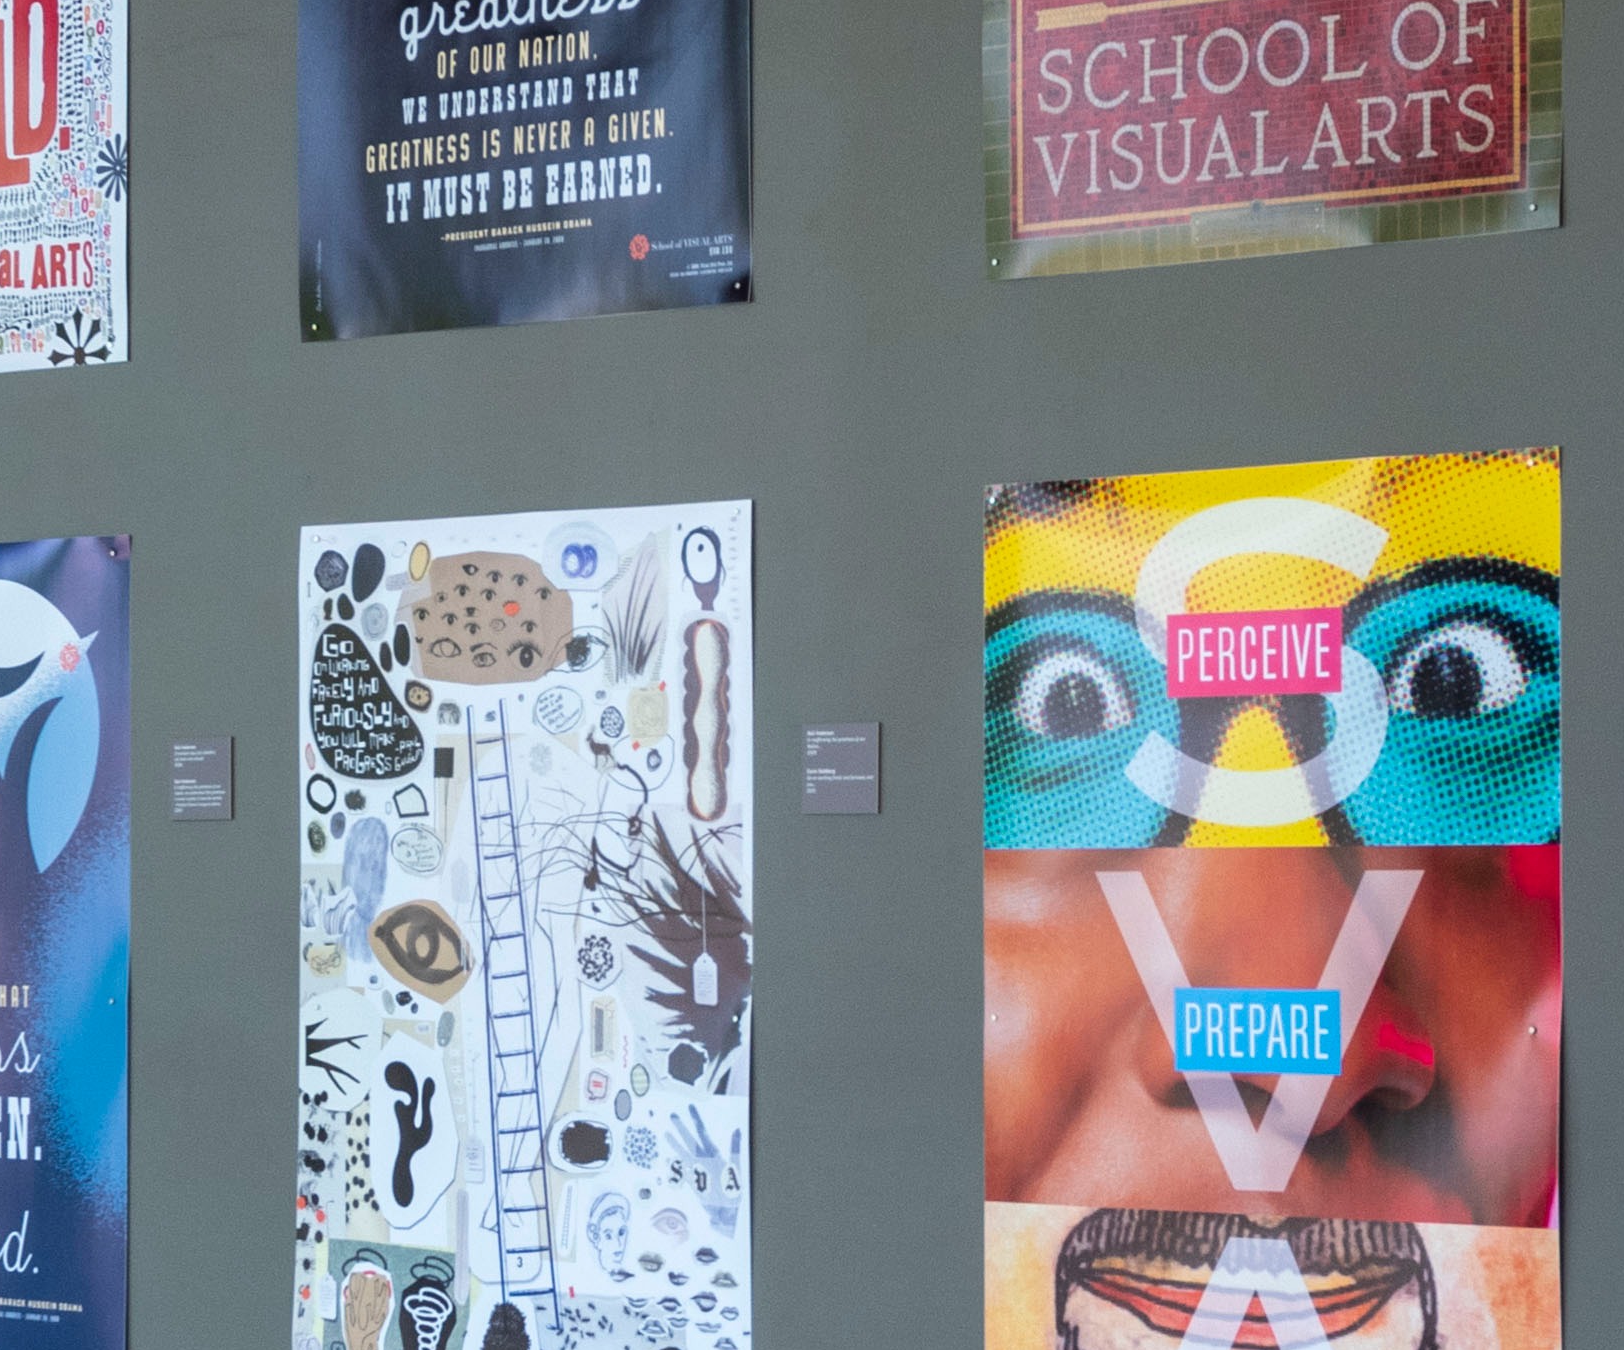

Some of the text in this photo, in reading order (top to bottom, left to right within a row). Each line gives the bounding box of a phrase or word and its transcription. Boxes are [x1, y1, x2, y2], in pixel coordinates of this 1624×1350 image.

[436, 48, 458, 79] OF
[469, 43, 506, 75] OUR
[1037, 13, 1368, 115] SCHOOL
[402, 68, 639, 125] WE UNDERSTAND THAT
[365, 108, 674, 173] GREATNESS IS NEVER A GIVEN.
[1033, 83, 1497, 197] VISUAL ARTS
[386, 153, 662, 223] IT MUST BE EARNED.
[32, 240, 94, 290] ARTS
[1177, 622, 1330, 683] PERCEIVE
[1184, 1002, 1329, 1060] PREPARE
